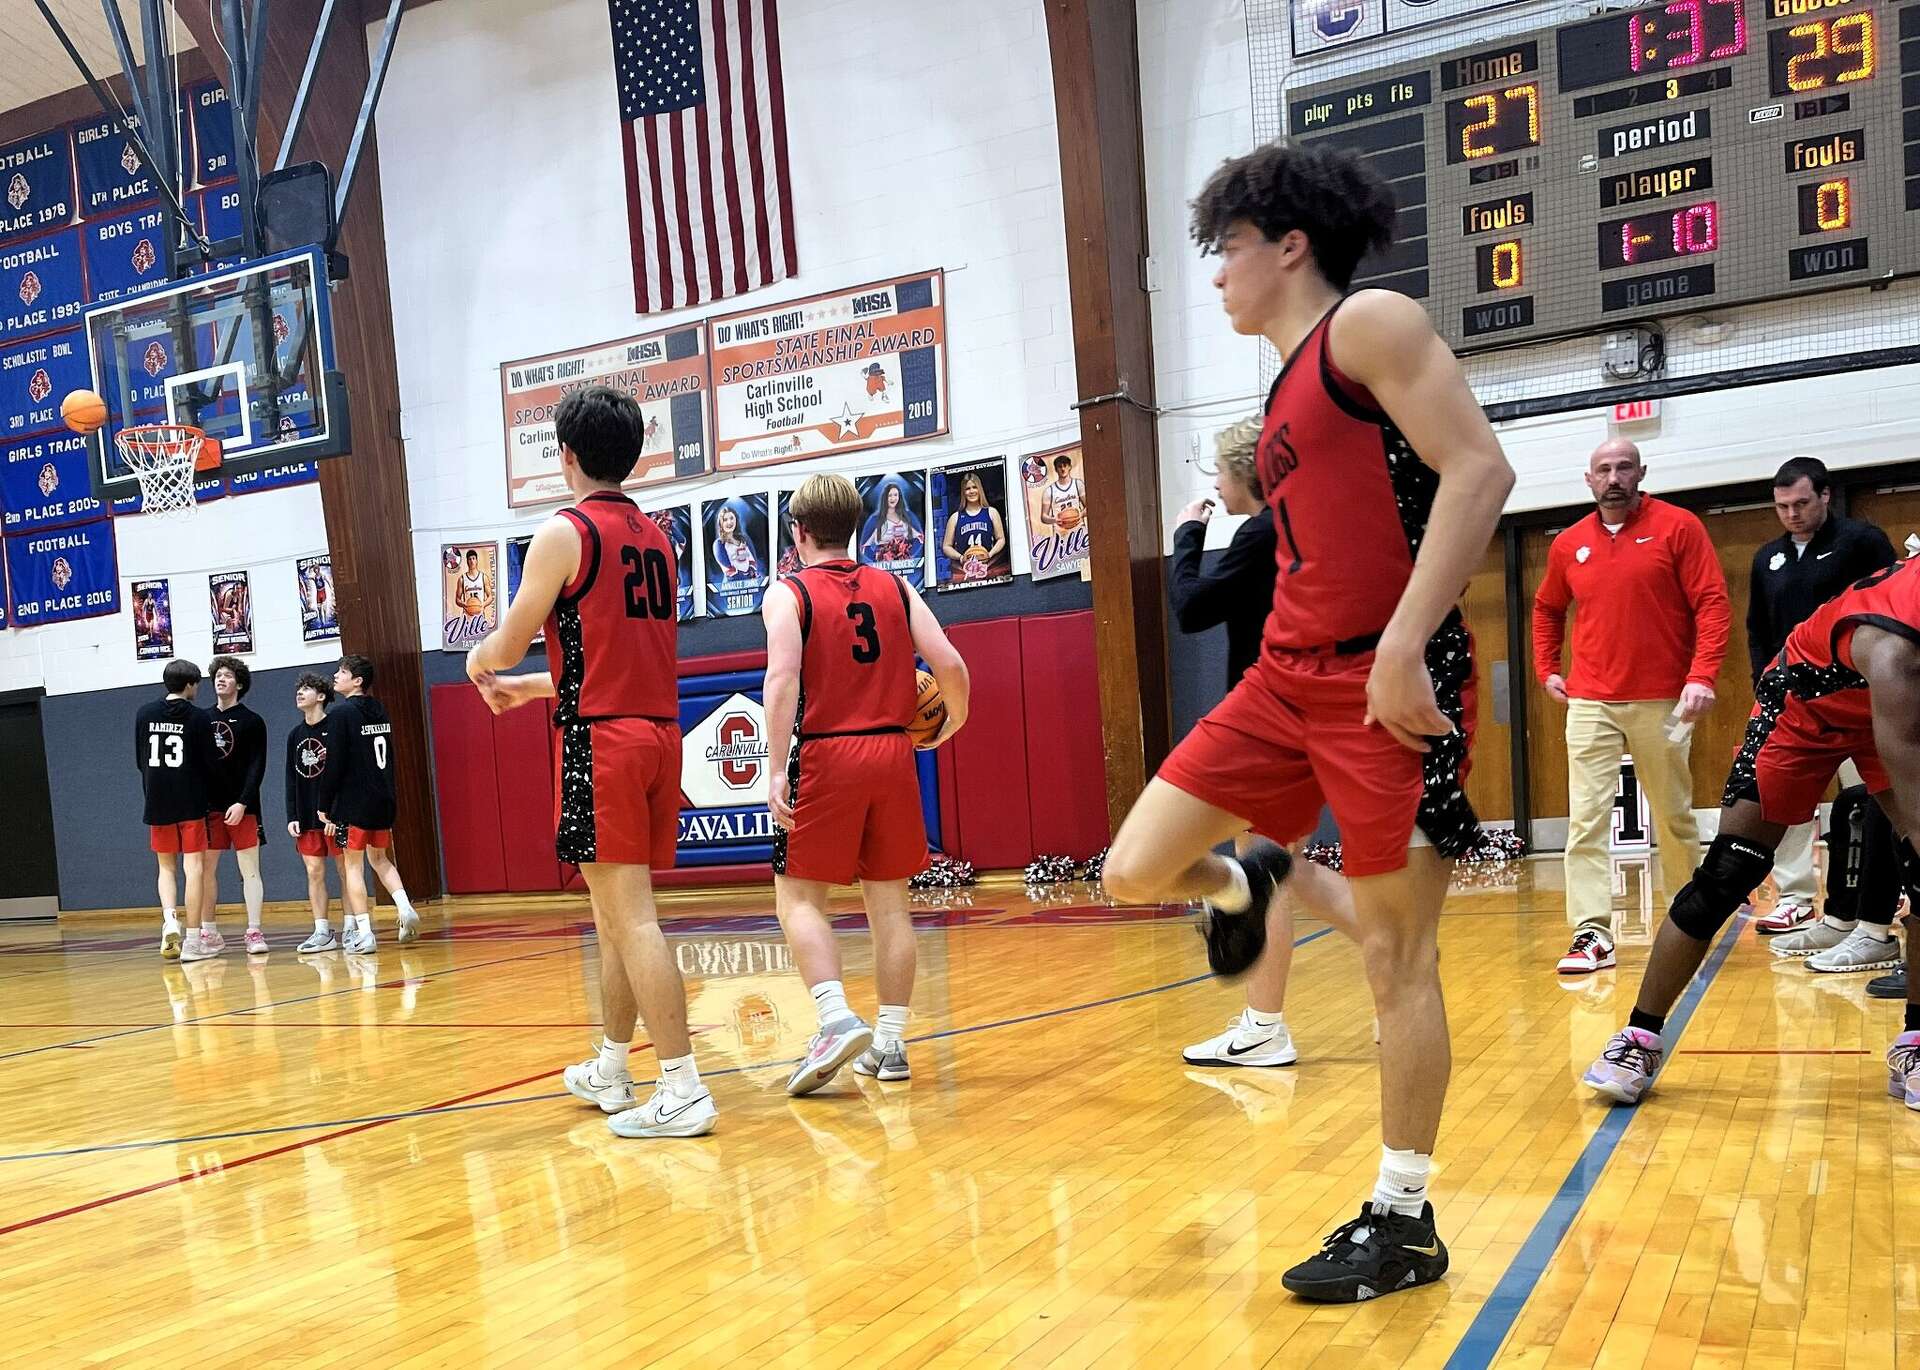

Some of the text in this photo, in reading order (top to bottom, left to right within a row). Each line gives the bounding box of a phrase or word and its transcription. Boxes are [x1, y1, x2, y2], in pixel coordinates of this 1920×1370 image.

[1788, 12, 1873, 91] 29
[1456, 52, 1522, 84] Home
[1666, 79, 1678, 98] 3
[1304, 84, 1413, 125] plyr pts fls
[79, 125, 109, 144] GIRLS
[1463, 86, 1536, 161] 27
[1614, 111, 1696, 157] period
[1794, 137, 1854, 169] fouls
[113, 179, 148, 201] PLACE
[1616, 167, 1696, 205] player
[39, 203, 66, 222] 1978
[1471, 200, 1525, 232] fouls
[1817, 181, 1847, 231] 0
[99, 221, 133, 240] BOYS
[0, 244, 59, 270] OOTBALL
[1493, 242, 1520, 288] 0
[1804, 248, 1854, 273] won
[1627, 275, 1689, 307] game
[8, 310, 47, 331] PLACE
[52, 301, 80, 320] 1993
[718, 311, 804, 344] DO WHAT'S RIGHT!
[1476, 305, 1521, 329] won
[776, 323, 876, 356] STATE FINAL
[3, 342, 72, 370] SCHOLASTIC BOWL
[723, 329, 935, 383] SPORTSMANSHIP AWARD
[511, 359, 584, 388] DO WHAT'S RIGHT!
[604, 371, 648, 391] FINAL
[645, 375, 700, 400] AWARD
[746, 376, 813, 400] Carlinville
[9, 414, 24, 429] 3RD
[30, 408, 53, 425] PLACE
[745, 390, 823, 420] High School
[766, 413, 804, 430] Football
[8, 436, 87, 463] GIRLS TRACK
[679, 443, 700, 459] 2009
[741, 451, 750, 460] Do
[774, 444, 793, 455] Right!
[25, 503, 64, 521] PLACE
[28, 533, 90, 554] FOOTBALL
[136, 582, 163, 592] SENIOR
[212, 573, 246, 586] SENIOR
[621, 545, 672, 620] 20
[948, 577, 1003, 591] BASKETBALL
[17, 602, 40, 617] 2ND
[44, 595, 82, 612] PLACE
[86, 590, 112, 606] 2016
[727, 595, 753, 609] SENIOR
[445, 615, 487, 643] Ville
[846, 602, 881, 665] 3
[149, 723, 184, 735] RAMIREZ
[149, 734, 183, 768] 13
[374, 735, 386, 770] 0
